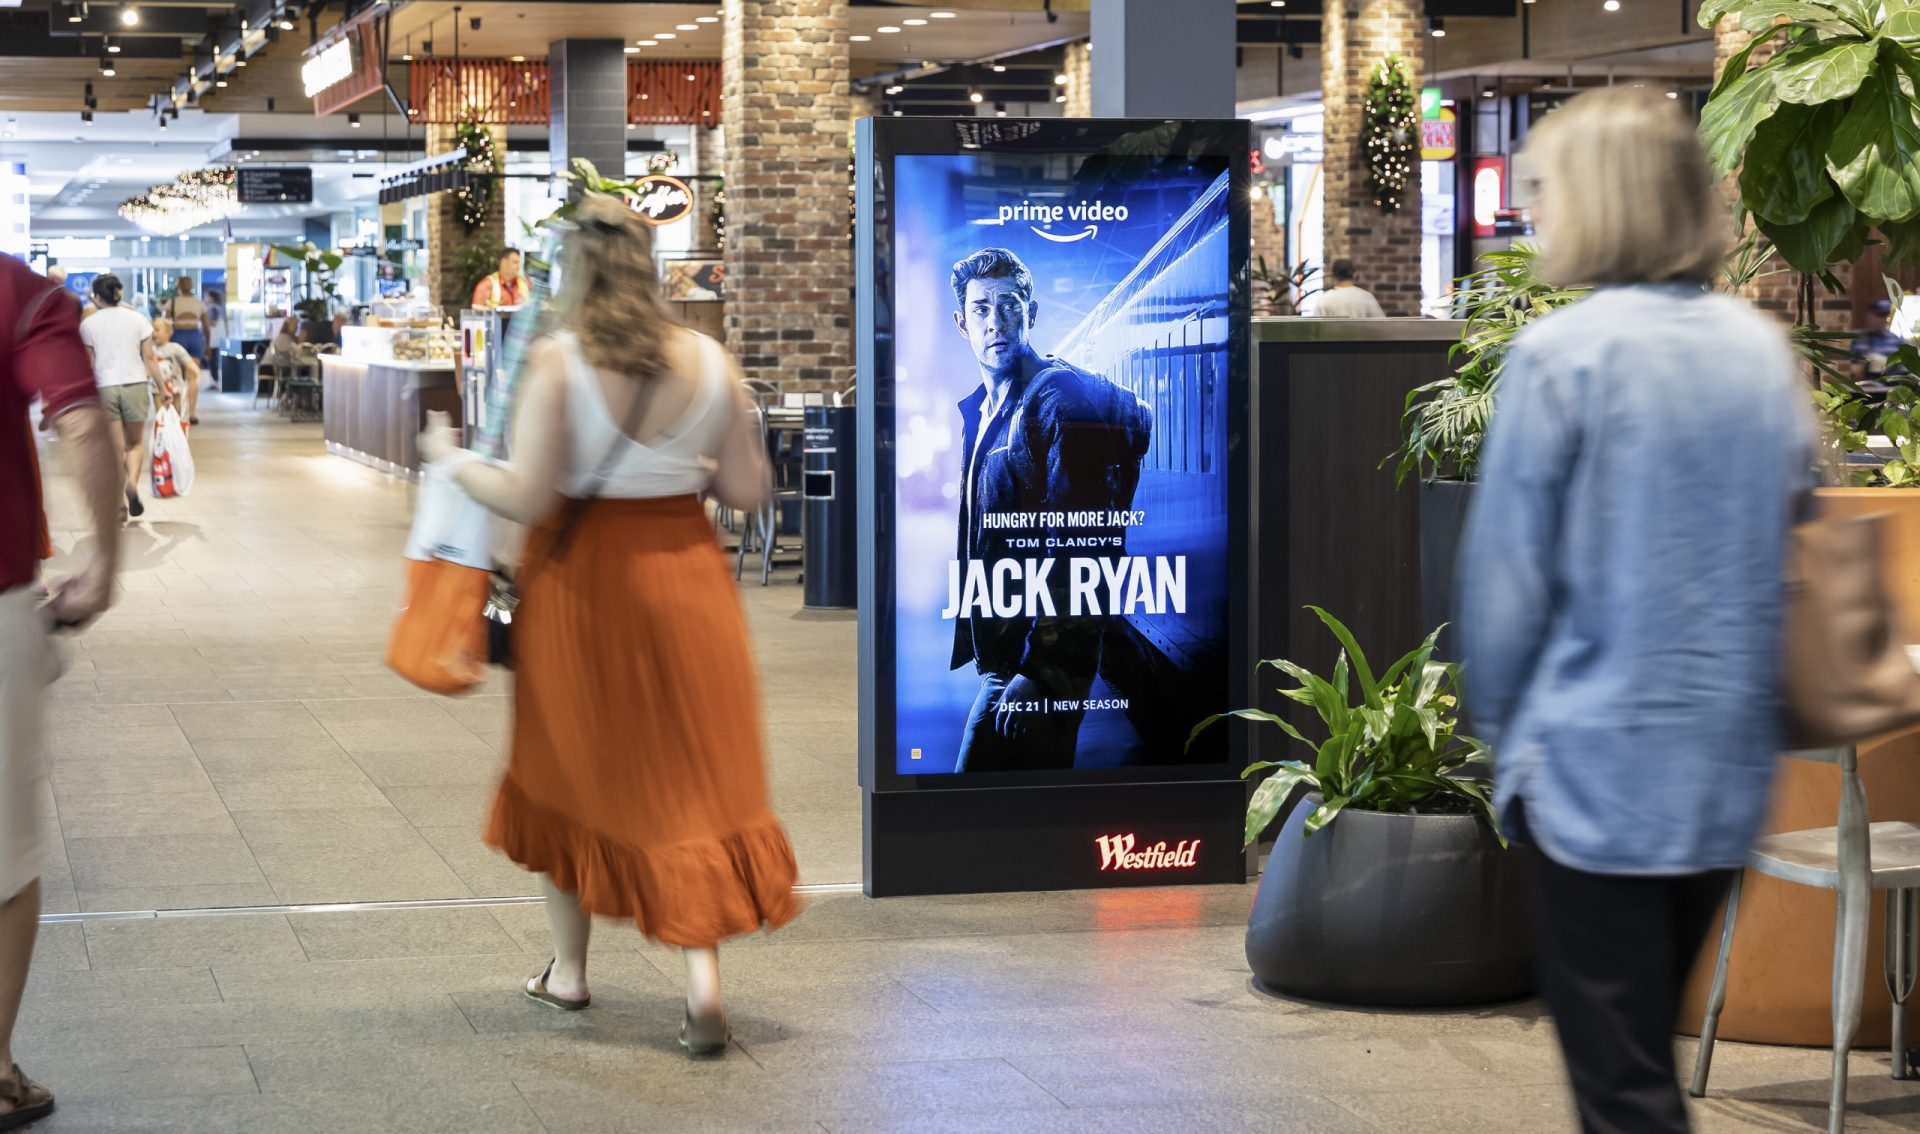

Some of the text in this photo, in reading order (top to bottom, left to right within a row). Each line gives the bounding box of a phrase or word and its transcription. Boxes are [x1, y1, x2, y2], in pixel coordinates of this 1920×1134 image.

[999, 200, 1129, 226] prime video
[983, 511, 1145, 529] HUNGRY FOR MORE JACK?
[1006, 537, 1122, 548] TOM CLANCY'S
[942, 555, 1186, 619] JACK RYAN
[1000, 699, 1129, 712] DEC 21 NEW SEASON
[1095, 833, 1201, 870] Westfield
